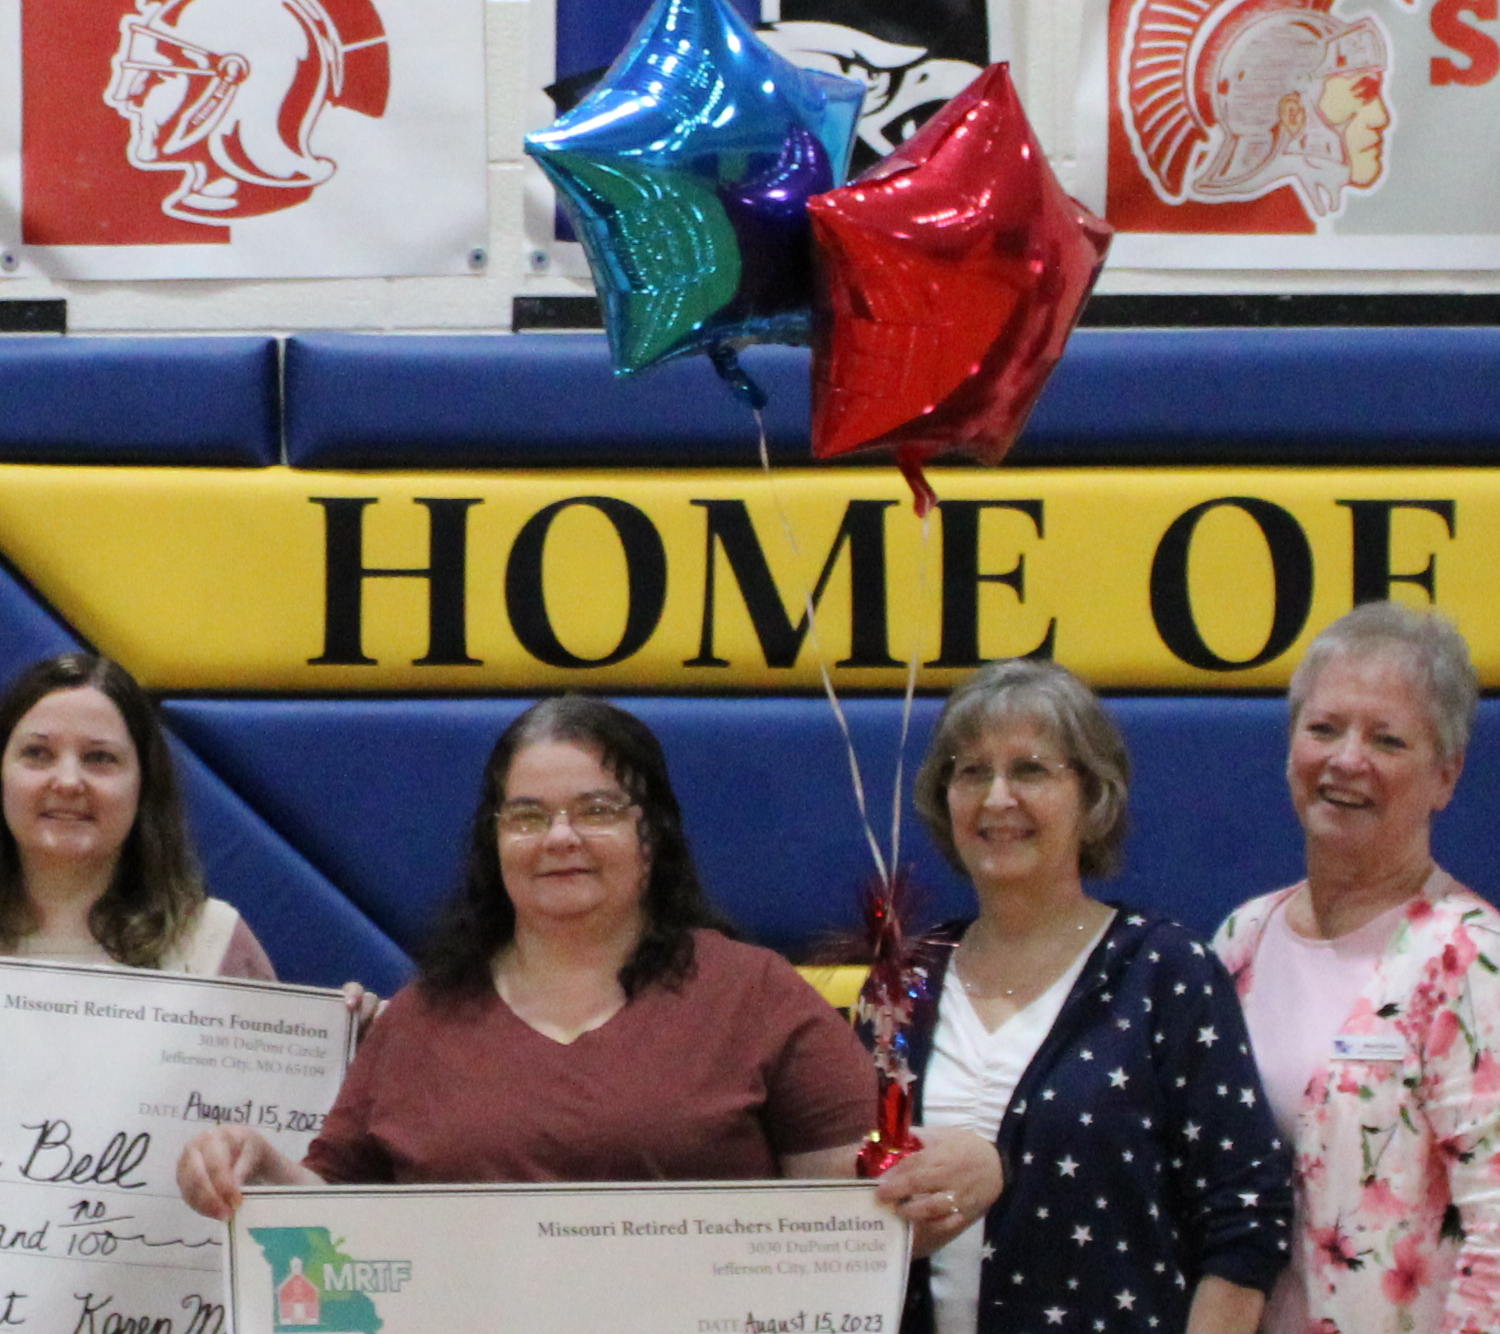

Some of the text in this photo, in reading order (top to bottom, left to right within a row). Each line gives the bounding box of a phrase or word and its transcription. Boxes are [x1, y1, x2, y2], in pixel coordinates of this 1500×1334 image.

[307, 492, 1458, 675] HOME OF
[3, 992, 328, 1040] Missouri Retired Teachers Foundation
[160, 1051, 217, 1068] Jefferson
[182, 1091, 253, 1127] August
[257, 1104, 282, 1133] 15,
[18, 1118, 151, 1191] Bell
[537, 1217, 886, 1238] Missouri Retired Teachers Foundation
[322, 1259, 413, 1293] MRTF
[840, 1312, 884, 1334] 2023
